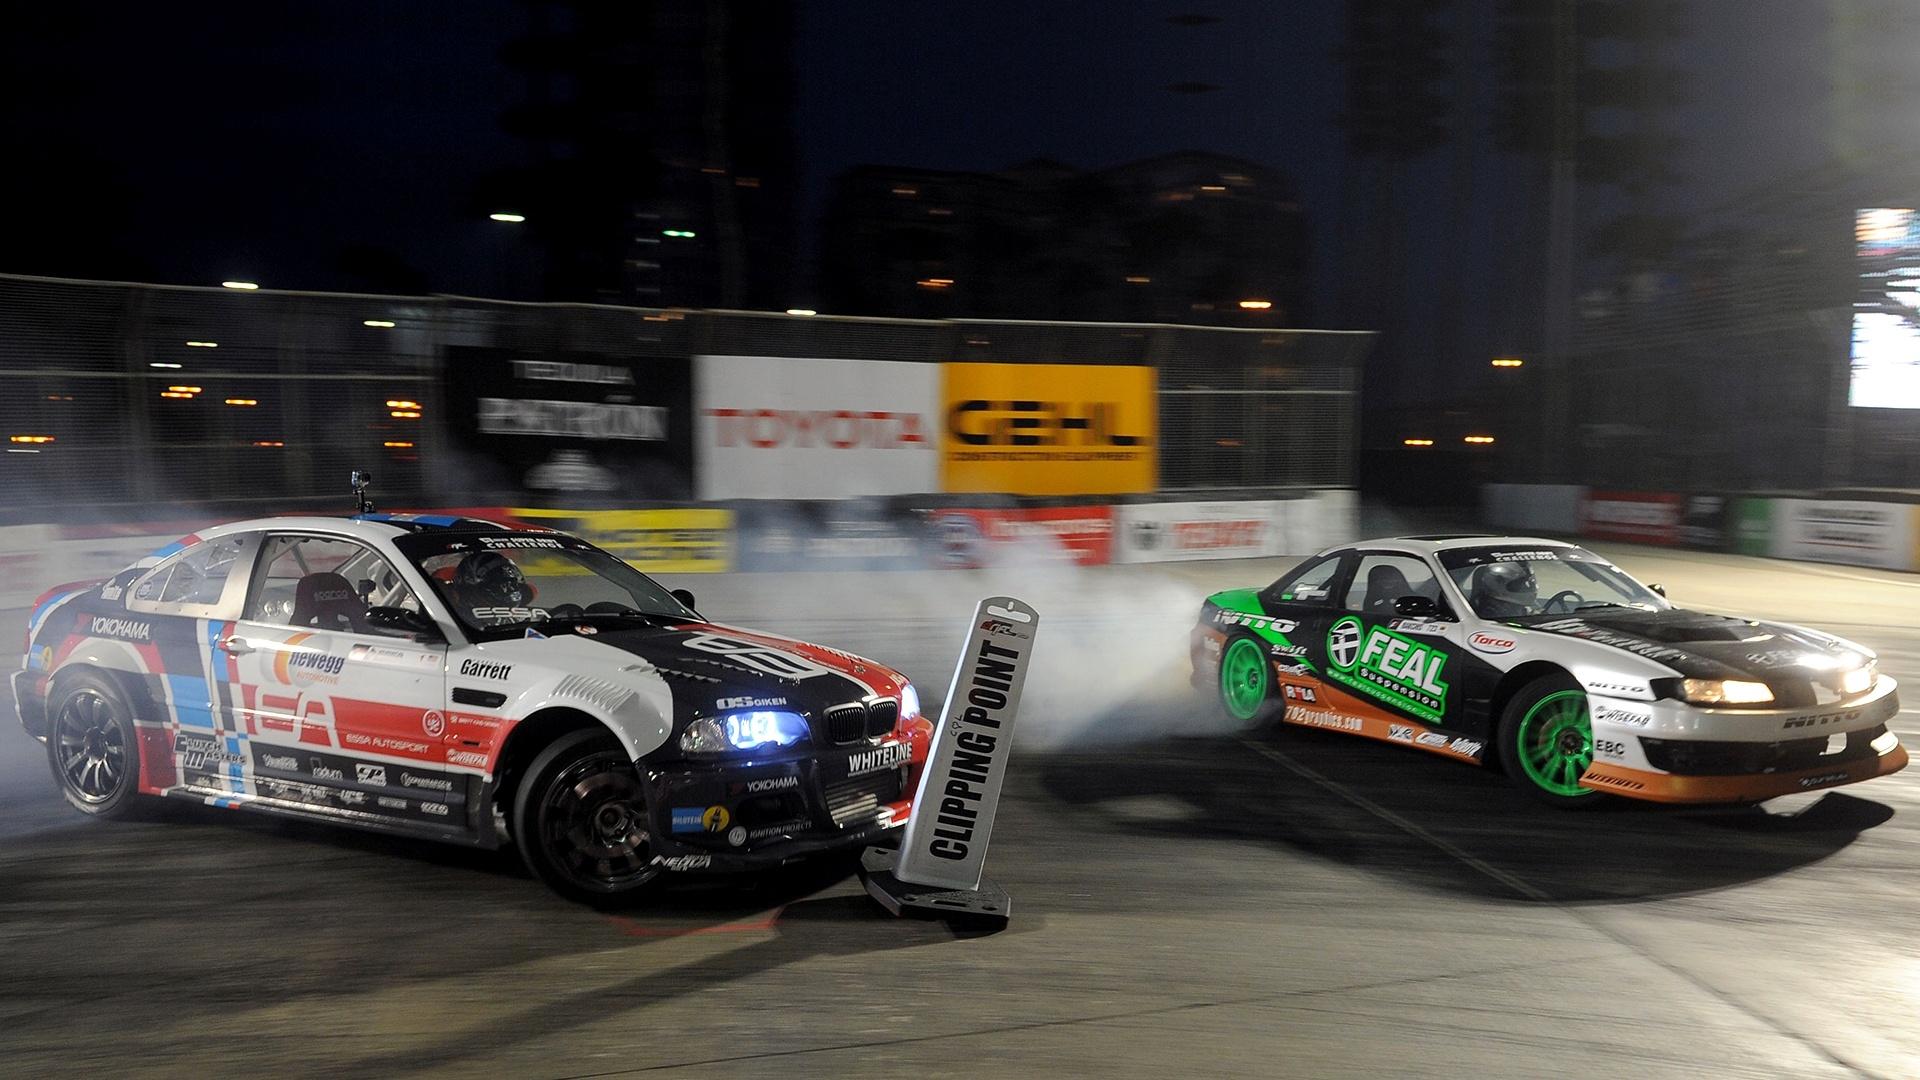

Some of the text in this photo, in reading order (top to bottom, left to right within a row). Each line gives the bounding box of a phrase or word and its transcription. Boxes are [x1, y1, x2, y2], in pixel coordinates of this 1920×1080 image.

[707, 408, 932, 450] TOYOTA
[950, 400, 1139, 446] GEHL
[472, 606, 551, 619] ESSA
[91, 616, 151, 640] YOKOHAMA
[1271, 644, 1308, 656] swift
[1472, 633, 1516, 648] Torco
[289, 650, 345, 675] newegg
[460, 658, 512, 680] Garrett
[1361, 631, 1443, 696] FEAL
[963, 640, 1020, 729] POINT
[1360, 668, 1438, 709] Suspension
[753, 697, 787, 706] GIKEN
[1783, 709, 1862, 729] NITTO
[372, 738, 430, 754] AUTOSPORT
[848, 741, 912, 773] WHITELINE
[1596, 740, 1625, 755] EBC
[748, 776, 798, 792] YOKOHAMA
[929, 731, 998, 861] CLIPPING
[750, 825, 782, 839] IGNITION
